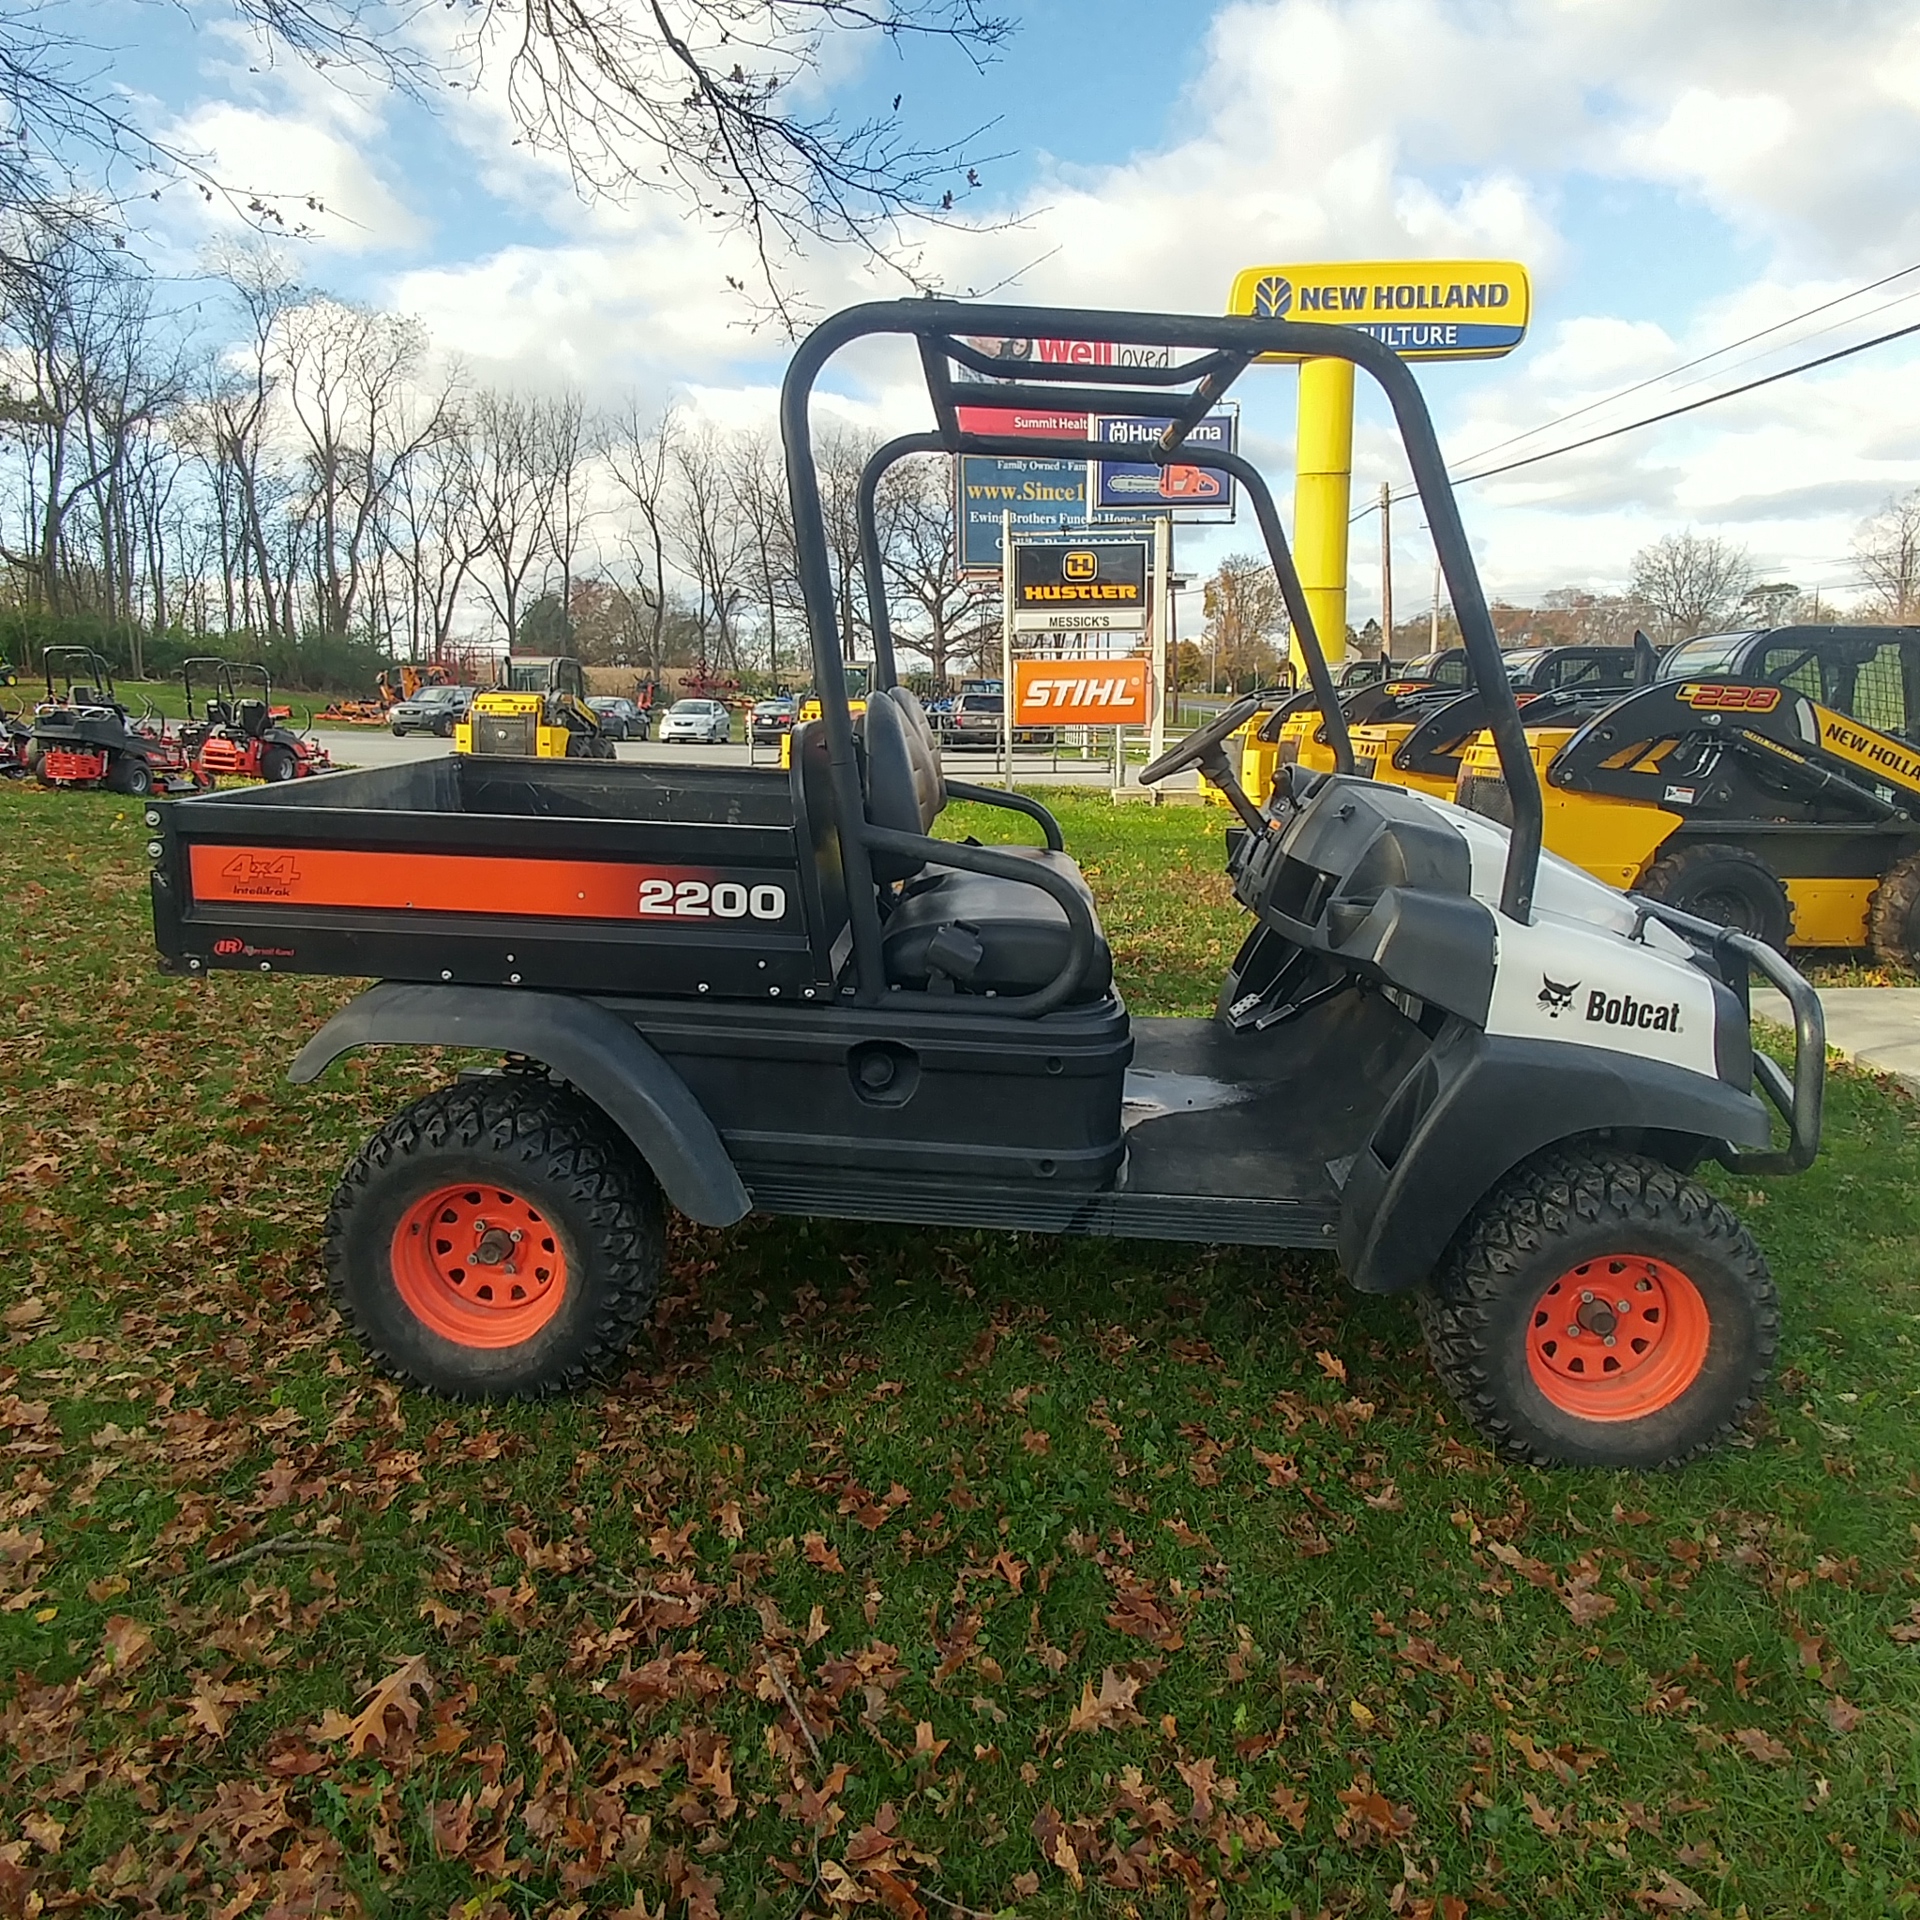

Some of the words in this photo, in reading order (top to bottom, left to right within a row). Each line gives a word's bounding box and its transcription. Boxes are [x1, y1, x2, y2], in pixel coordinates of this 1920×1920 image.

[1300, 286, 1367, 311] NEW
[1373, 283, 1509, 310] HOLLAND
[1357, 325, 1458, 346] ULTURE
[1037, 338, 1113, 367] Well
[1118, 342, 1169, 369] loved
[1014, 417, 1057, 430] Summit
[997, 460, 1027, 472] Family
[1029, 461, 1060, 471] Owned
[966, 481, 1085, 501] www.Since1
[1010, 511, 1057, 524] Brothers
[1059, 512, 1101, 524] Funeal
[1023, 584, 1138, 601] HUSTLER
[1048, 615, 1110, 628] MESSICK'S
[1022, 678, 1136, 708] STIHL
[1676, 683, 1781, 711] L228
[1825, 722, 1870, 753] NEW
[221, 853, 301, 886] 4x4
[233, 885, 291, 898] IntelliTrak
[637, 879, 787, 921] 2200
[1585, 990, 1681, 1034] Bobcat
